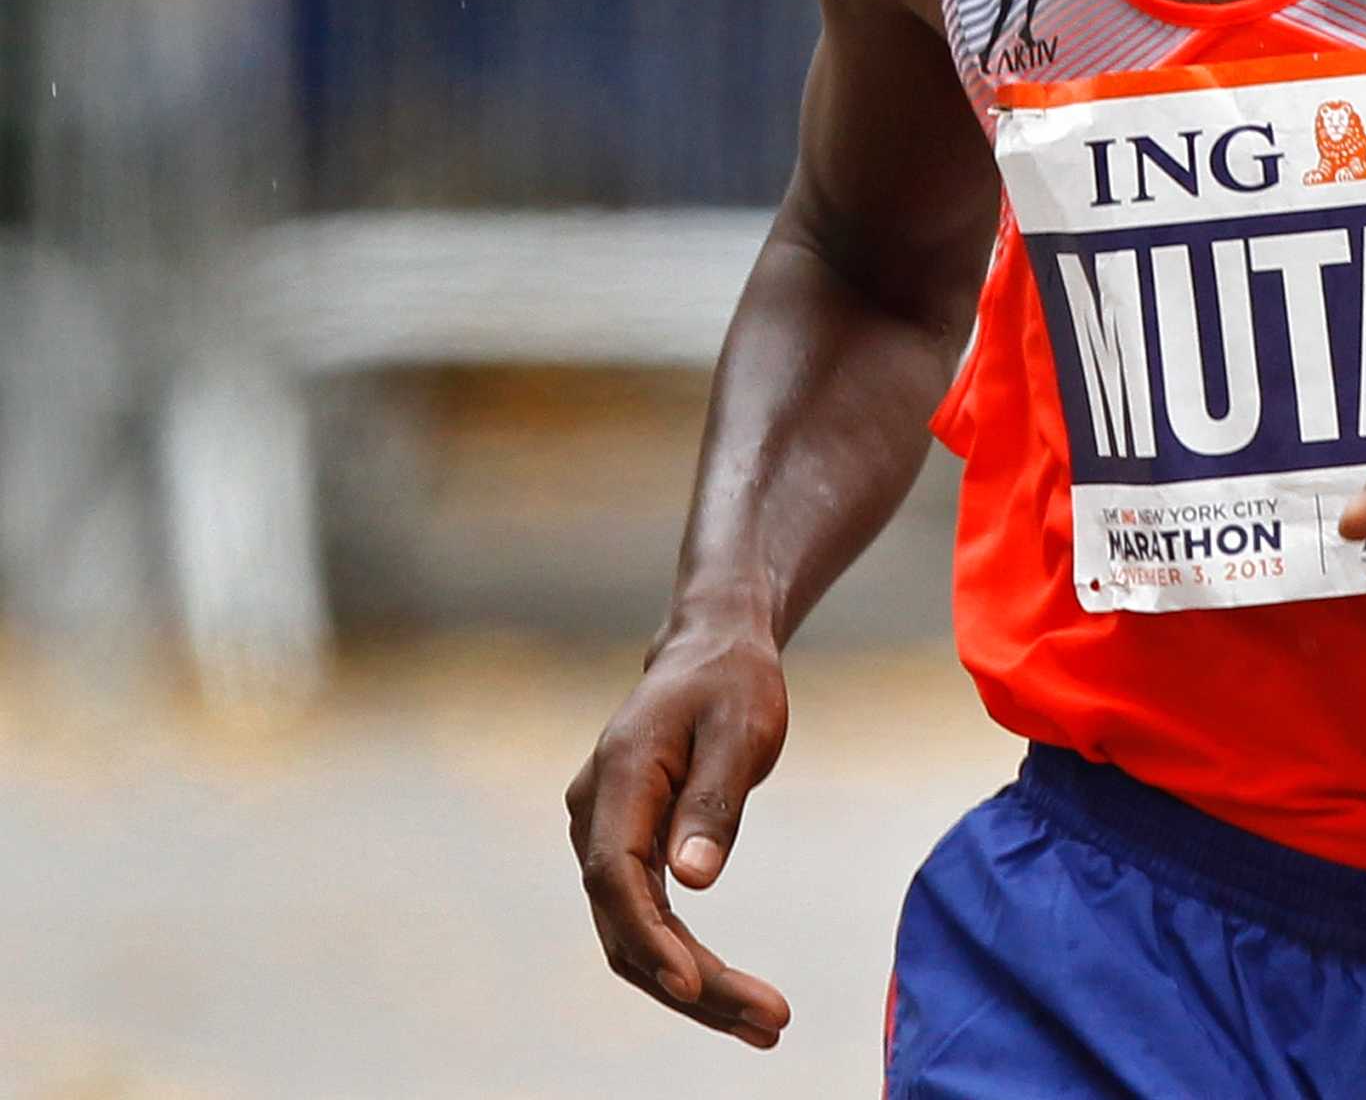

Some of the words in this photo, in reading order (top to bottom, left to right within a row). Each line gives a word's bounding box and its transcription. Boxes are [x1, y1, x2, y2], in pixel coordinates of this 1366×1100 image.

[1084, 122, 1285, 208] ING
[1168, 501, 1227, 524] YORK
[1232, 499, 1279, 519] CITY
[1107, 519, 1282, 563] MARATHON
[1223, 557, 1285, 581] 2013
